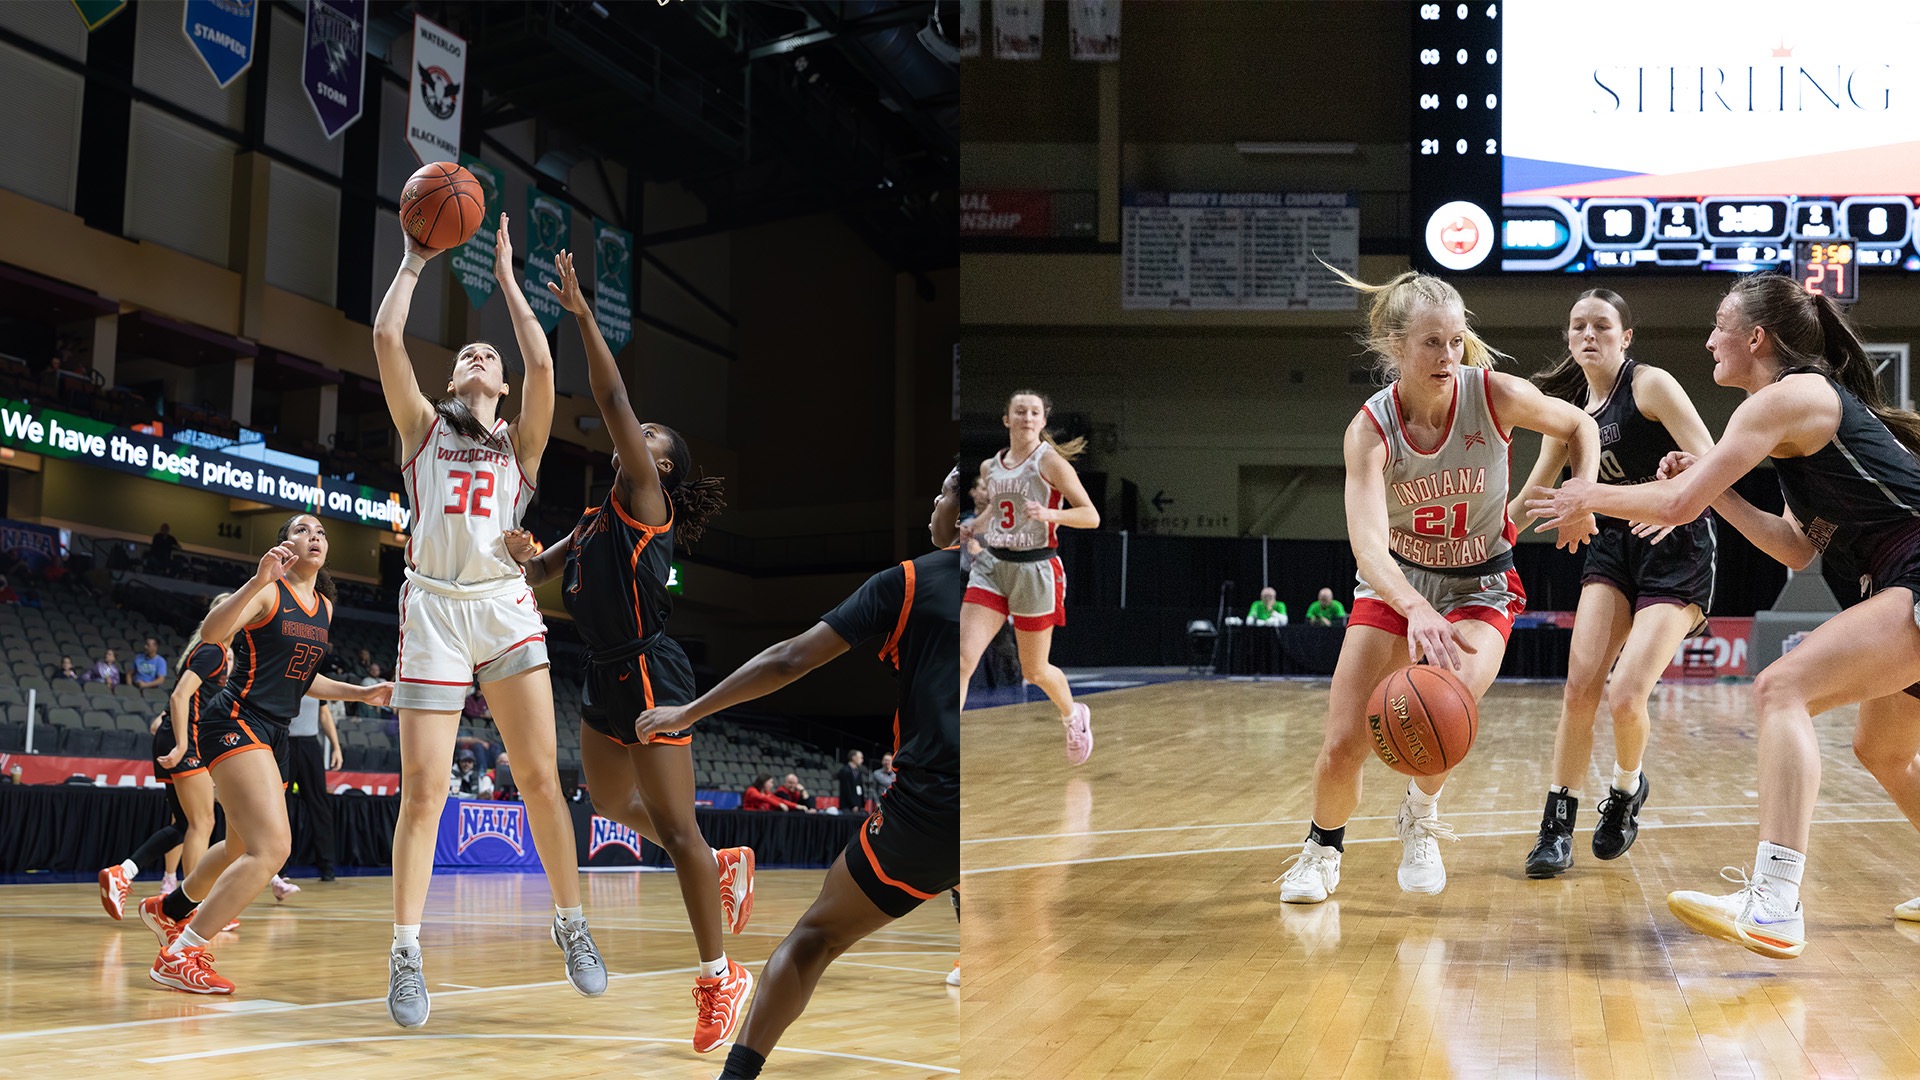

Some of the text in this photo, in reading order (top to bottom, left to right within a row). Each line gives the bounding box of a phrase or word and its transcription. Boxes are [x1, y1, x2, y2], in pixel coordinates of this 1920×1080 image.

[1420, 3, 1497, 20] 02 0 4
[193, 22, 248, 60] STAMPEDE
[420, 27, 461, 58] WATERLOO
[1457, 48, 1468, 65] 0
[1486, 48, 1497, 65] 0
[316, 81, 348, 108] STORM
[1420, 93, 1497, 110] 04 0 0
[411, 126, 457, 157] BLACK HAWKS
[1420, 138, 1497, 155] 21 0 2
[1811, 244, 1851, 264] 3:50
[451, 256, 498, 285] Champion
[1804, 264, 1844, 295] 27
[1, 408, 45, 443] We
[48, 419, 107, 458] have
[110, 435, 149, 467] the
[152, 444, 200, 479] best
[203, 460, 254, 491] price
[256, 468, 276, 496] in
[279, 476, 325, 507] town
[328, 488, 352, 513] on
[354, 494, 411, 527] quality
[437, 446, 509, 467] WILDCATS
[444, 469, 495, 518] 32
[1391, 467, 1487, 507] INDIANA
[999, 499, 1015, 530] 3
[1412, 501, 1470, 540] 21
[2, 528, 54, 557] NAIA
[218, 522, 242, 539] 114
[1388, 526, 1489, 567] WESLEYAN
[285, 642, 324, 681] 23
[1368, 713, 1399, 765] NAIA
[1390, 694, 1434, 765] SPALDING
[460, 805, 522, 851] NAIA
[591, 818, 641, 856] NAIA
